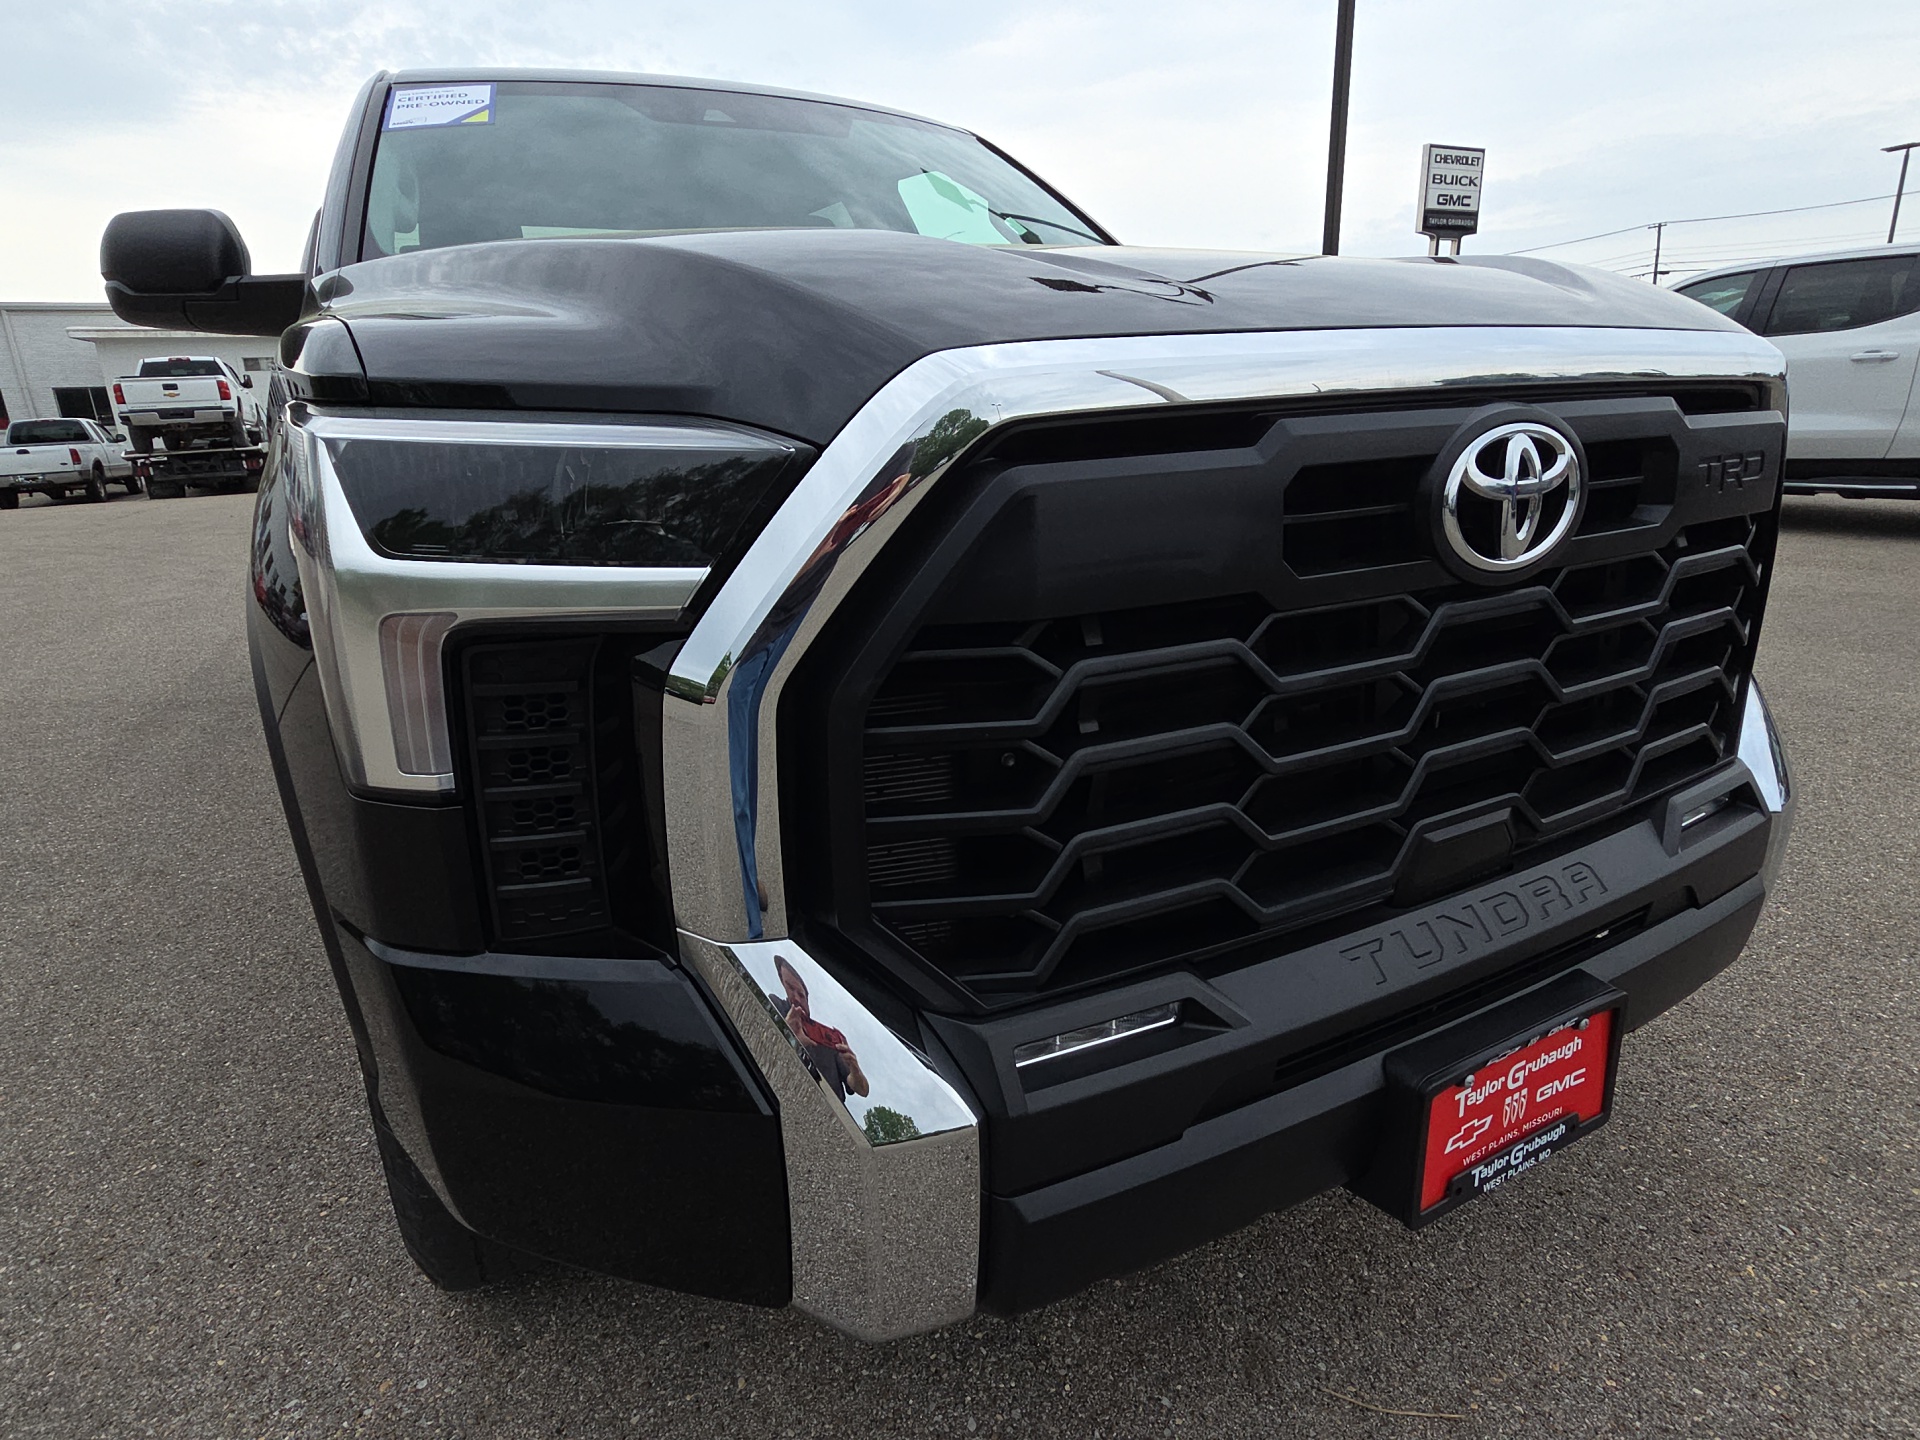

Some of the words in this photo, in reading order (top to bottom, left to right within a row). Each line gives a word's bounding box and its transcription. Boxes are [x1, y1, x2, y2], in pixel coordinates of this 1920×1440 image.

[397, 99, 485, 110] PRE-OWNED
[398, 92, 468, 103] CERTIFIED
[1434, 153, 1481, 167] CHEVROLET
[1432, 173, 1479, 187] BUICK
[1437, 193, 1472, 207] GMC
[1698, 450, 1765, 494] TRD
[1339, 861, 1608, 986] TUNDRA
[1454, 1077, 1506, 1118] Taylor
[1507, 1036, 1582, 1090] Grubaugh
[1536, 1067, 1587, 1102] GMC
[1462, 1146, 1487, 1167] WEST
[1522, 1106, 1563, 1133] MISSOURI
[1471, 1155, 1510, 1188] Taylor
[1510, 1123, 1566, 1166] Grubaugh
[1483, 1172, 1507, 1193] WEST
[1538, 1148, 1551, 1162] MO
